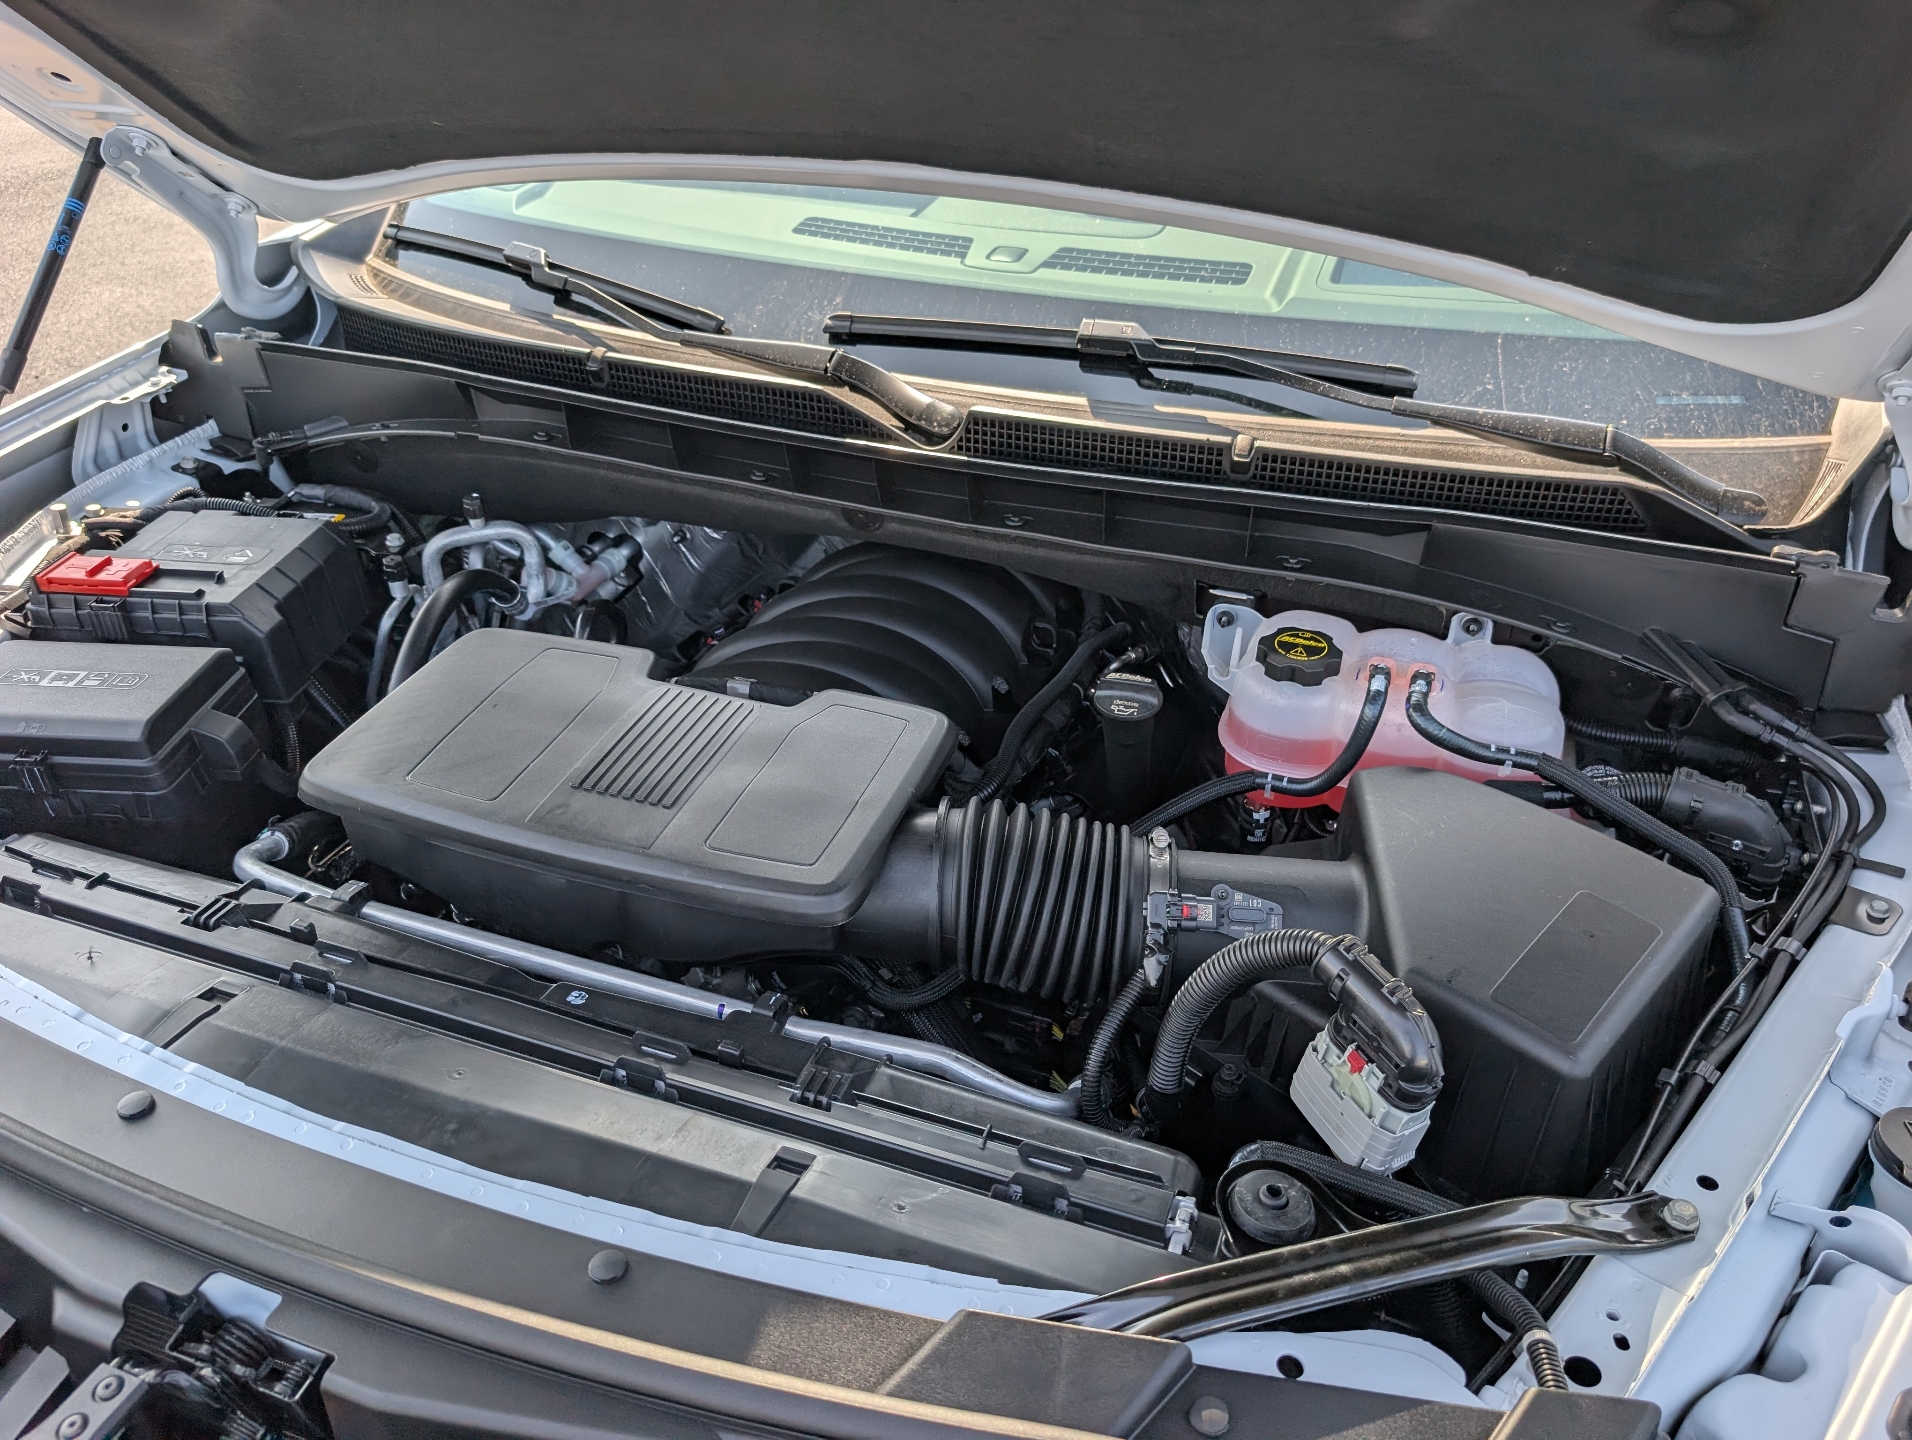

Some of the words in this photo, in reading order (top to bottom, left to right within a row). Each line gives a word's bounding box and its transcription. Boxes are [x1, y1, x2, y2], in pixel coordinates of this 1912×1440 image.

[1278, 636, 1326, 647] ACDelco
[1106, 672, 1152, 682] ACDelco
[1113, 699, 1139, 707] dexos
